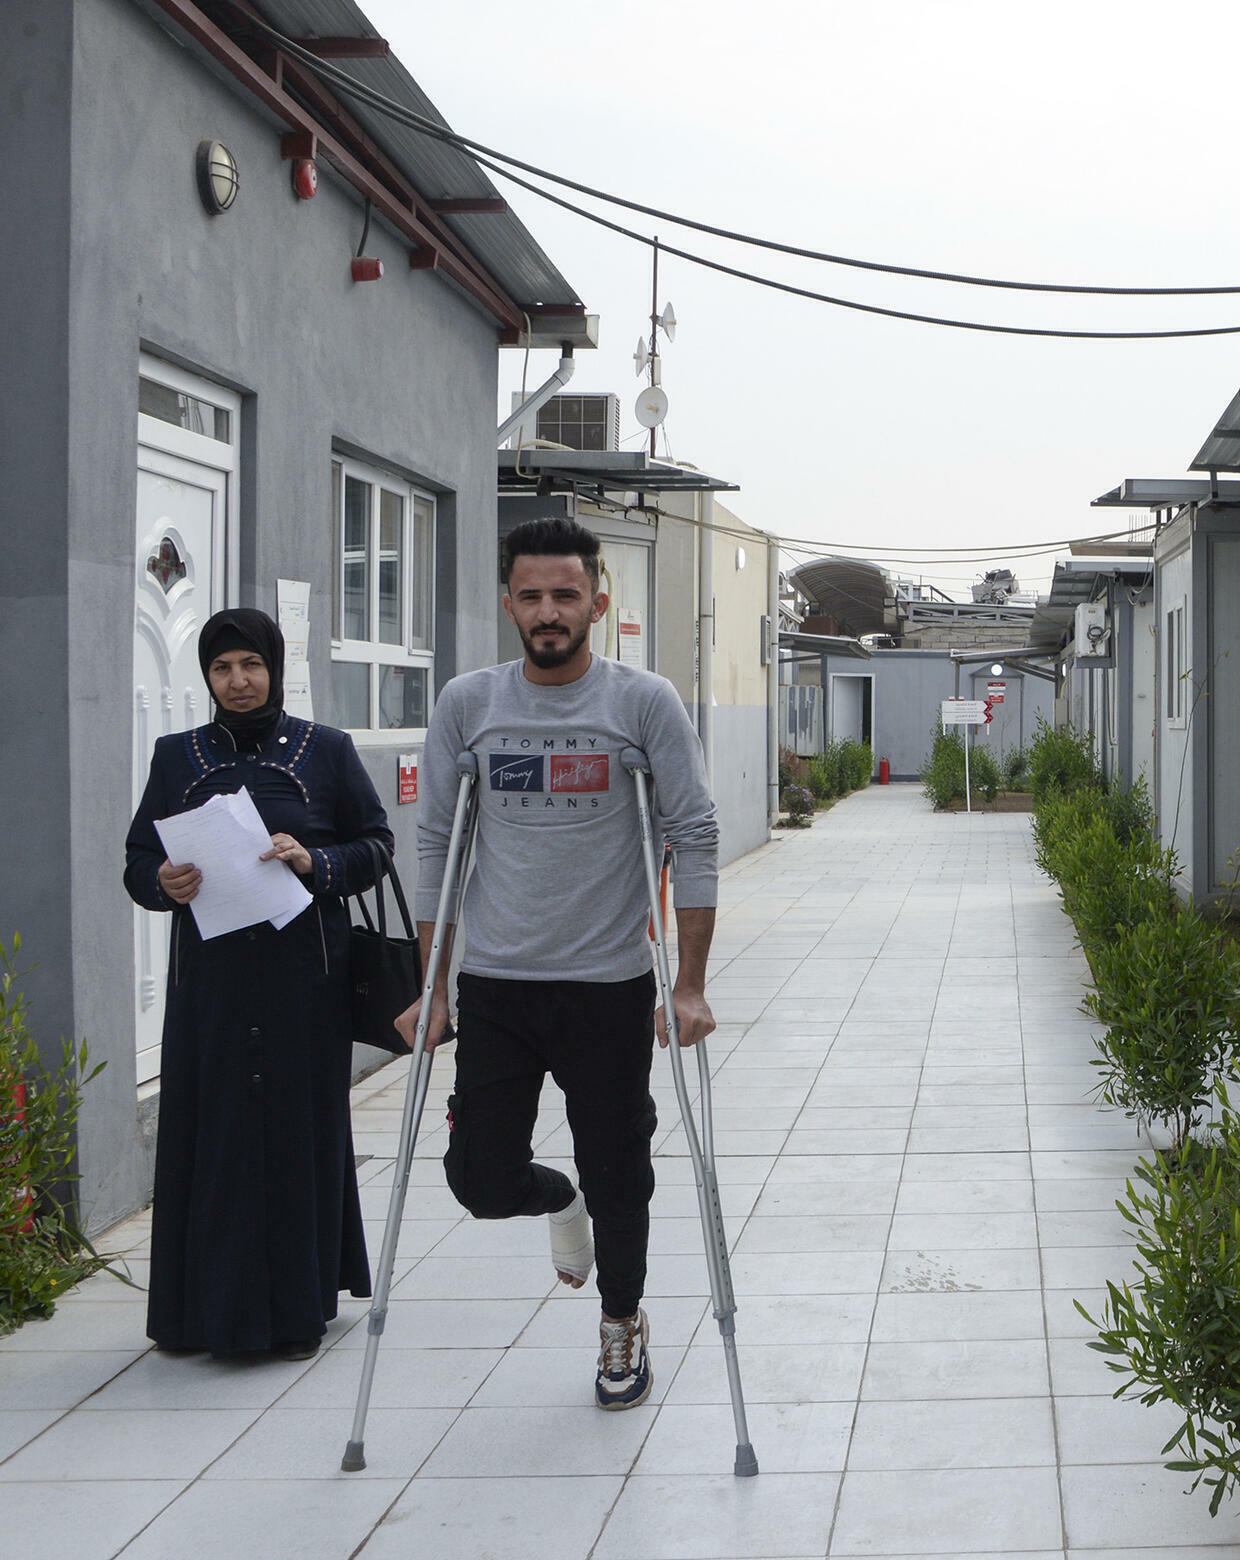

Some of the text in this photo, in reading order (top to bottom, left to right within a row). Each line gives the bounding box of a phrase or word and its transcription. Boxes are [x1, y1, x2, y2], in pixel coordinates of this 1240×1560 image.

[500, 738, 597, 750] TOMMY
[489, 755, 541, 790] Tommy
[501, 797, 600, 809] JEANS
